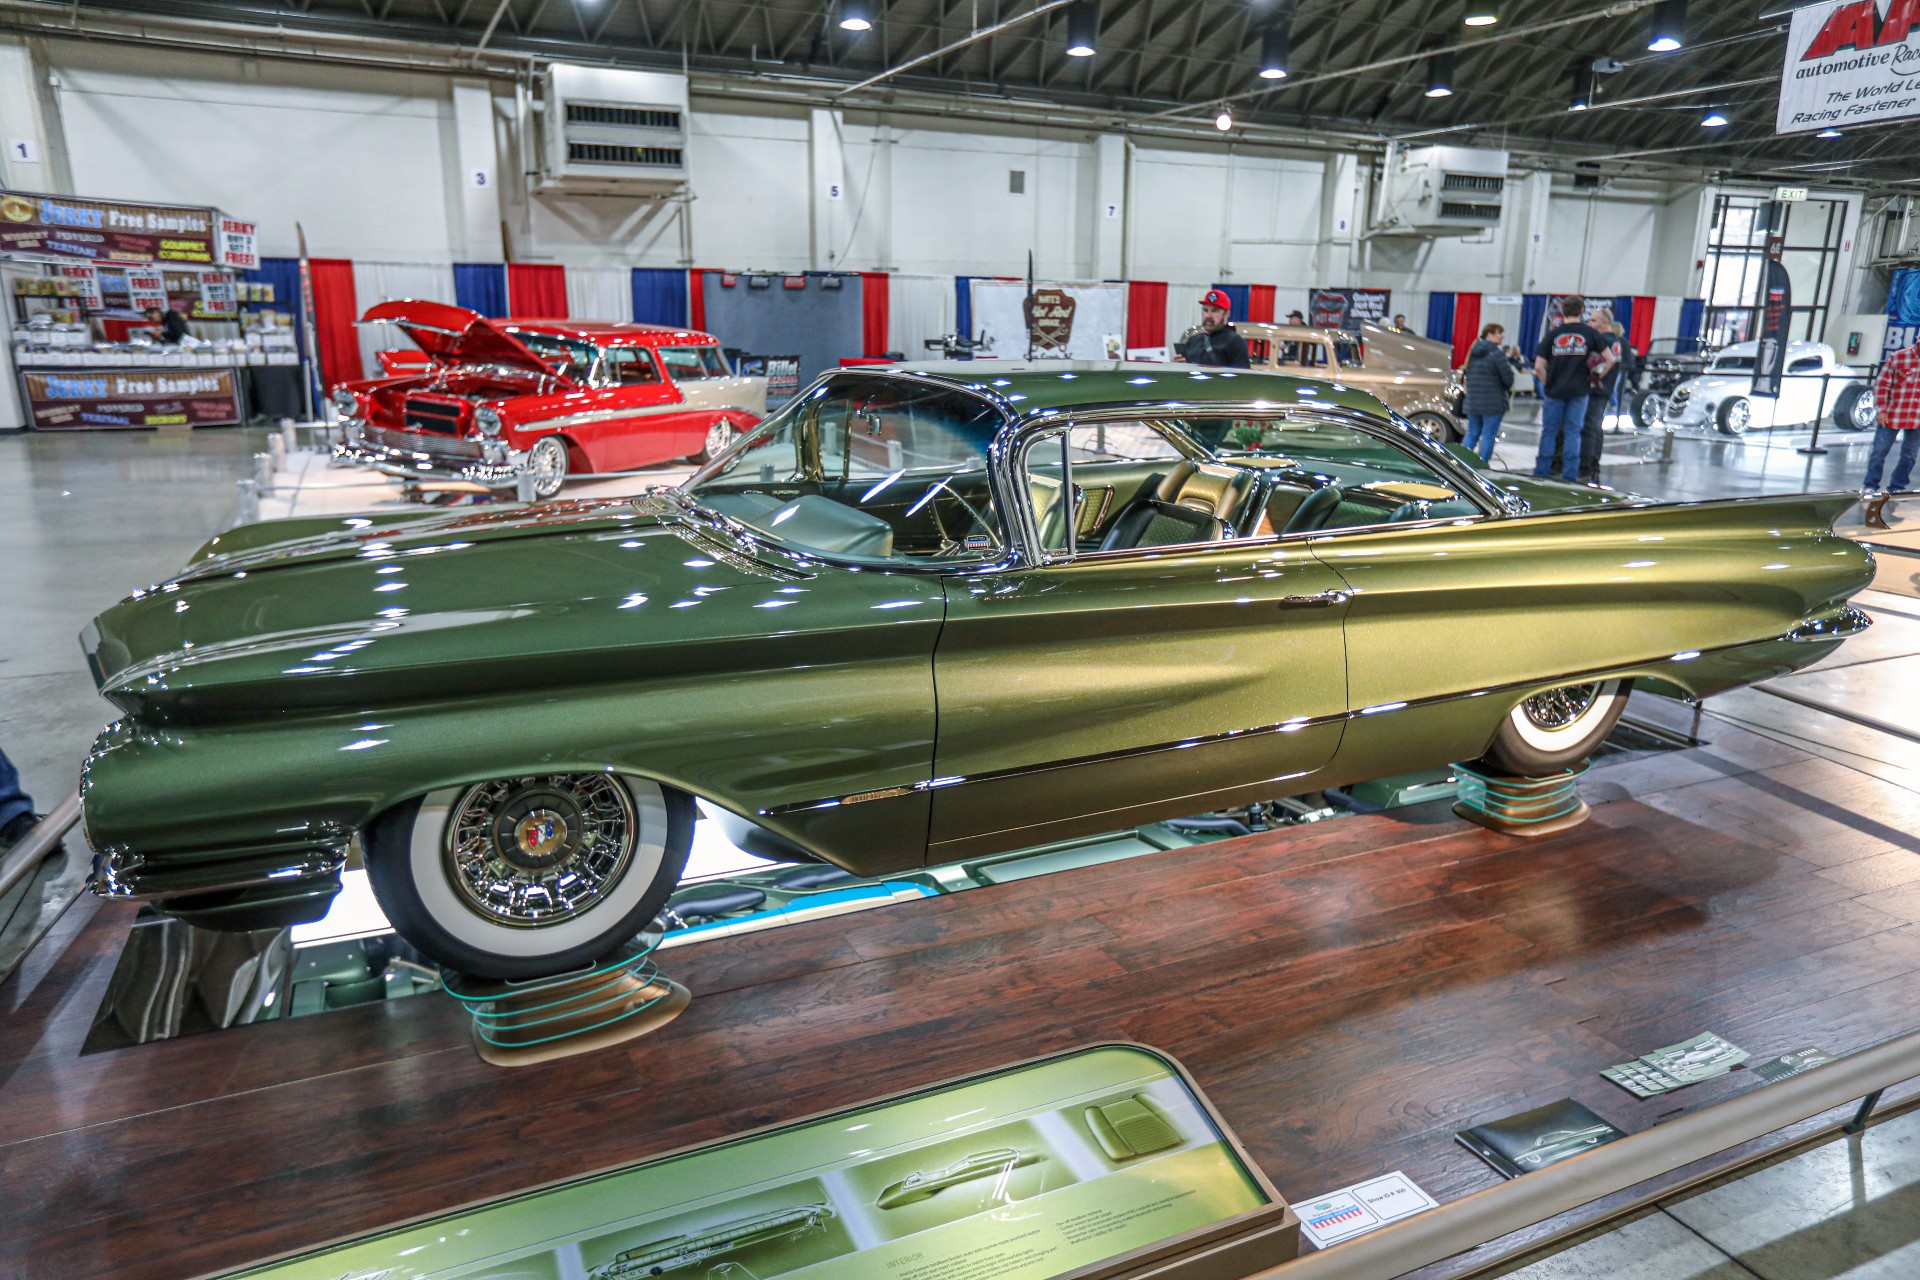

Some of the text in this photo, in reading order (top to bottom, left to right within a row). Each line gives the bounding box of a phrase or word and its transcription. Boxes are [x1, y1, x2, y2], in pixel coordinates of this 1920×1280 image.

[1795, 43, 1920, 79] automotive Rac
[1826, 92, 1852, 104] The
[1855, 80, 1904, 99] World
[1791, 97, 1916, 124] Racing Fastener
[17, 143, 28, 158] 1
[476, 172, 486, 185] 3
[831, 185, 839, 197] 5
[1781, 189, 1804, 199] EXIT
[39, 200, 206, 233] JERKY Free Samples
[1108, 206, 1116, 216] 7
[222, 220, 257, 236] JERKY
[202, 273, 232, 284] JERY
[1884, 326, 1920, 350] BU
[45, 375, 220, 398] JERKY Free Samples
[886, 1252, 925, 1270] INTERIOR
